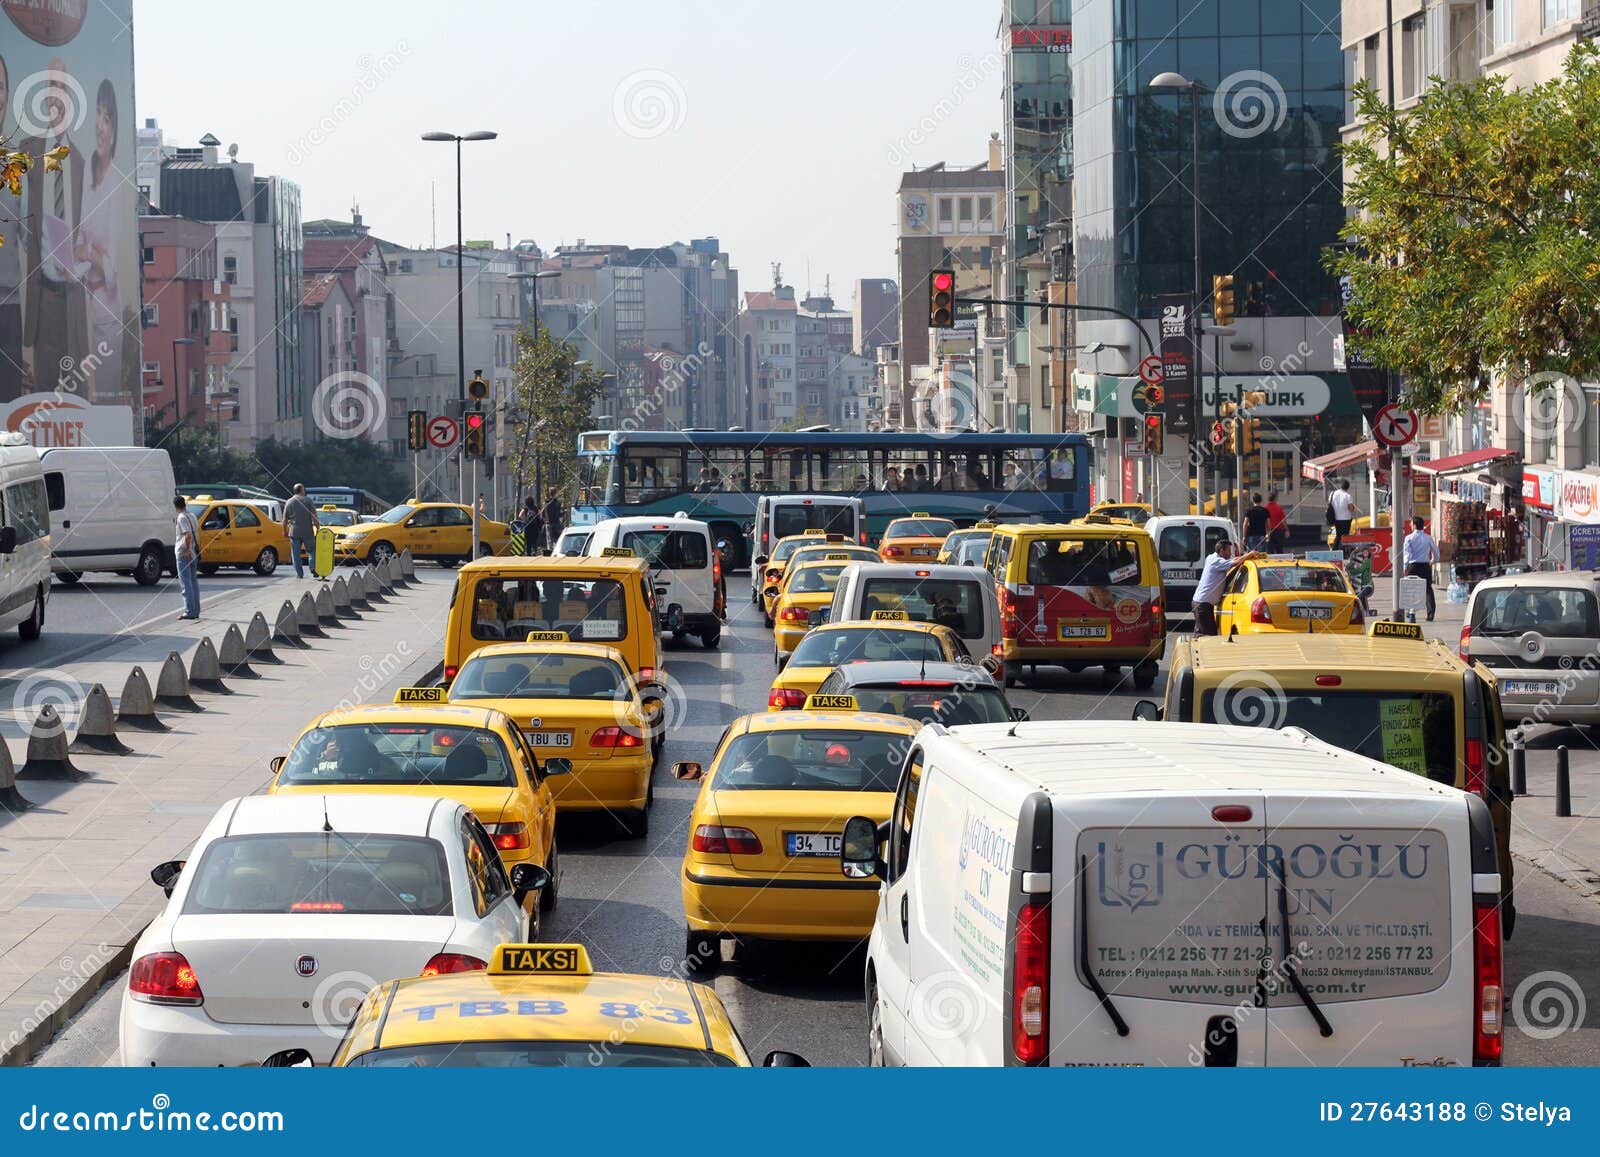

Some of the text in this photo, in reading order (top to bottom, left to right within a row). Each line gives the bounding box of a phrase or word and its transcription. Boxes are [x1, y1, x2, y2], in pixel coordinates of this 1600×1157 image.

[530, 733, 569, 745] TBU 05
[797, 835, 813, 851] 34
[1176, 834, 1431, 880] GÜROĞLU
[1098, 947, 1126, 961] TEL
[1140, 947, 1176, 961] 0212
[1180, 947, 1207, 961] 256
[1212, 947, 1229, 961] 77
[1327, 947, 1361, 961] 0212
[1366, 947, 1392, 960] 256
[1396, 946, 1413, 960] 77
[1417, 946, 1434, 960] 23
[403, 1000, 693, 1025] TBB 83
